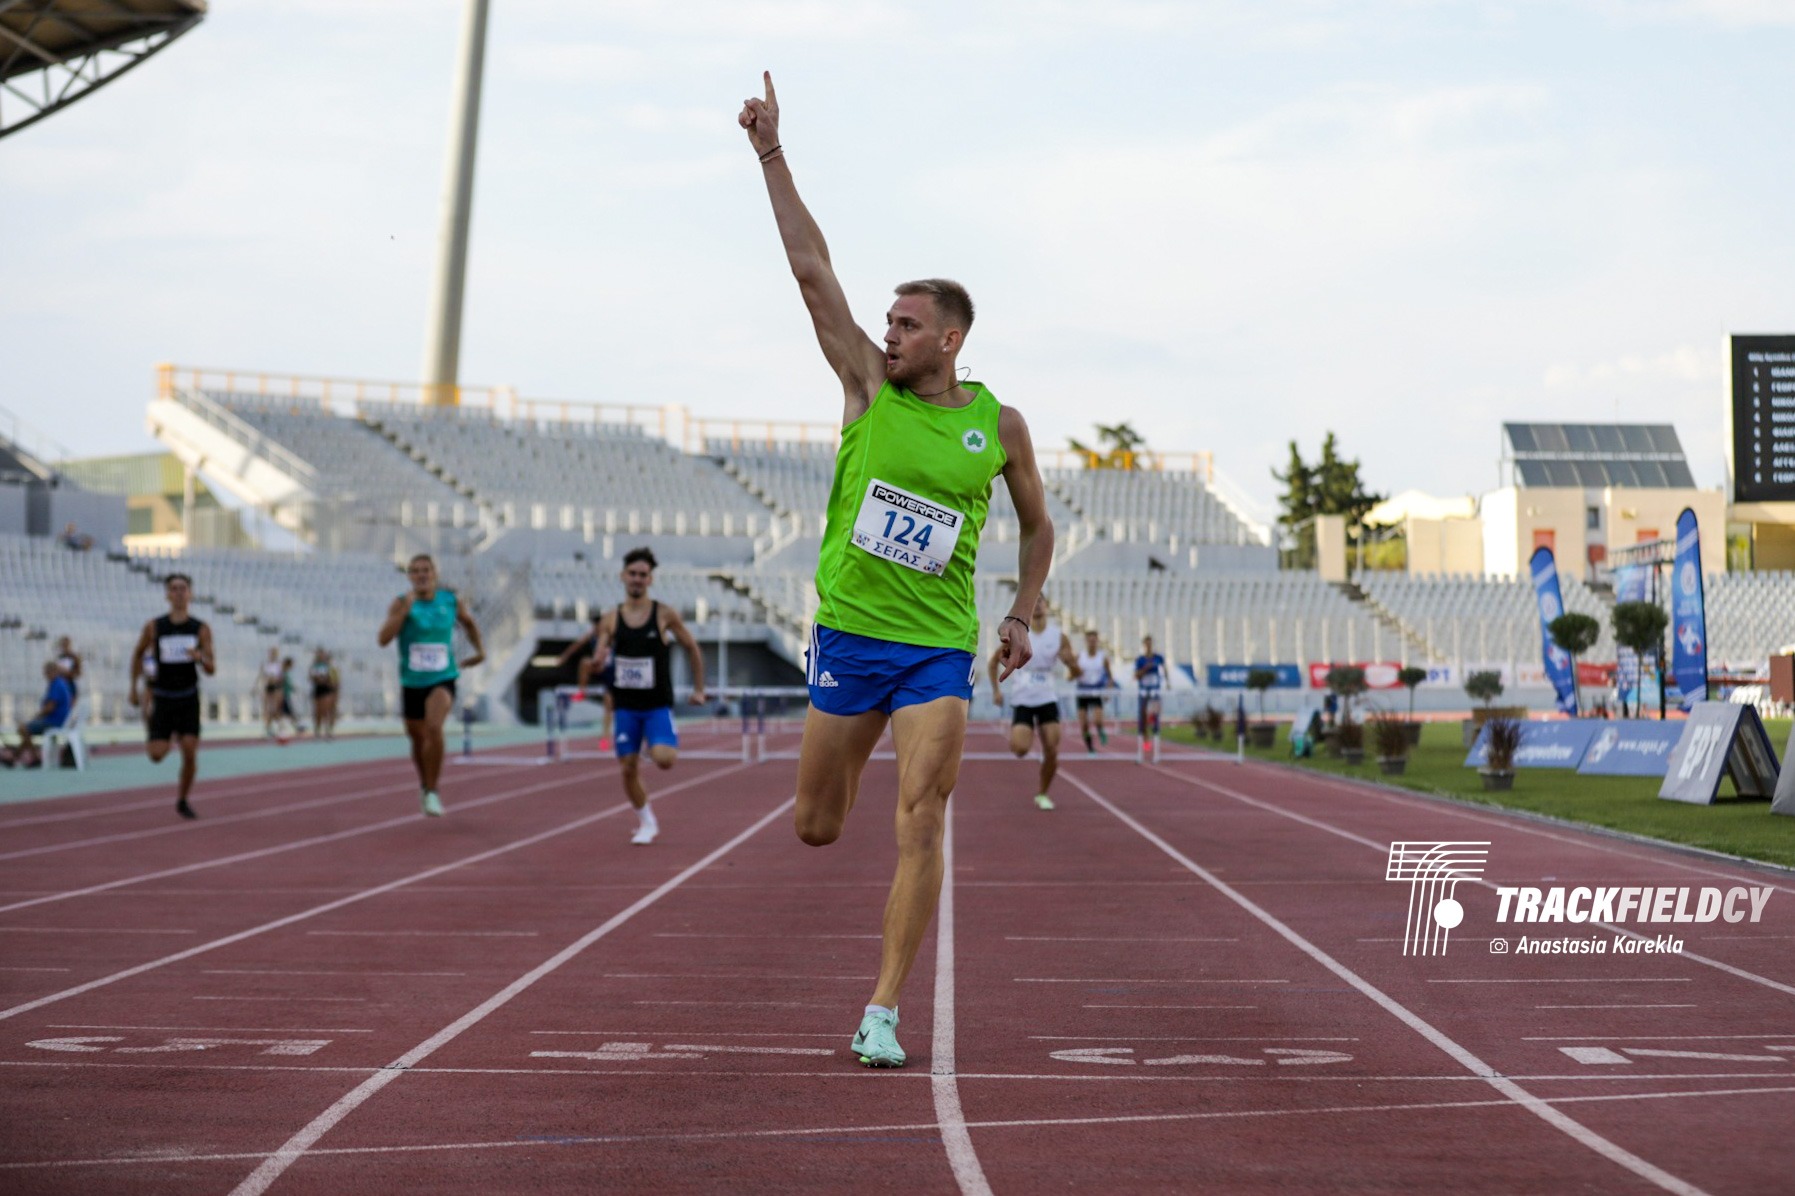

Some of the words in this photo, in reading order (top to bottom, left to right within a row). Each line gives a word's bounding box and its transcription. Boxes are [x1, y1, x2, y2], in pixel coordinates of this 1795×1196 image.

[874, 487, 955, 526] POWERADE
[882, 510, 934, 552] 124
[873, 541, 922, 567] ΣΕΓΑΣ
